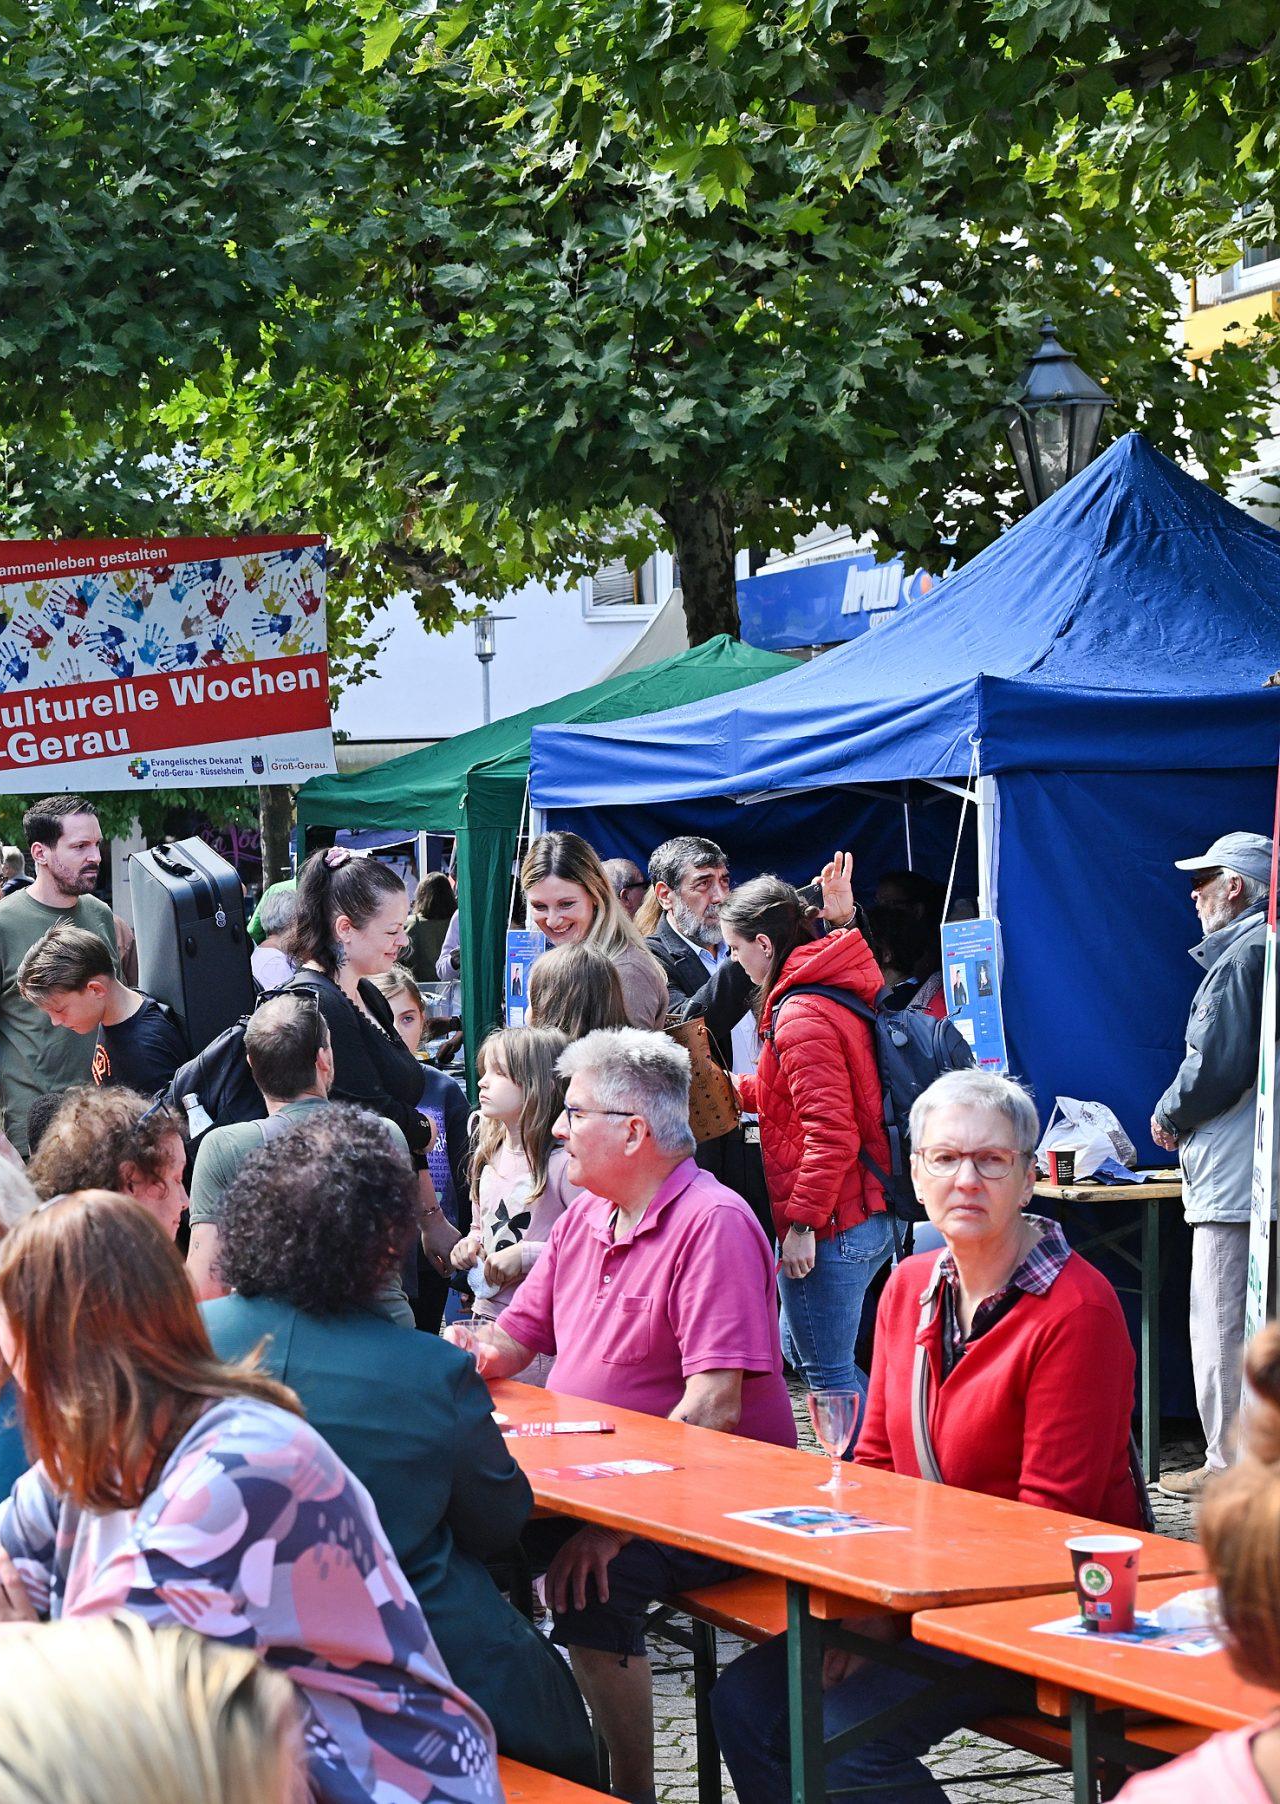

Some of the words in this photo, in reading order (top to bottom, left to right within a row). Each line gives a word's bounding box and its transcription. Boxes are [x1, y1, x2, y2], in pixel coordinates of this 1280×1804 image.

[100, 547, 168, 568] gestalten
[169, 665, 321, 708] Wochen
[150, 757, 208, 768] Evangelisches
[208, 756, 243, 765] Dekanat
[152, 768, 194, 778] Groß-Gerau
[200, 766, 245, 776] Rüsselsheim
